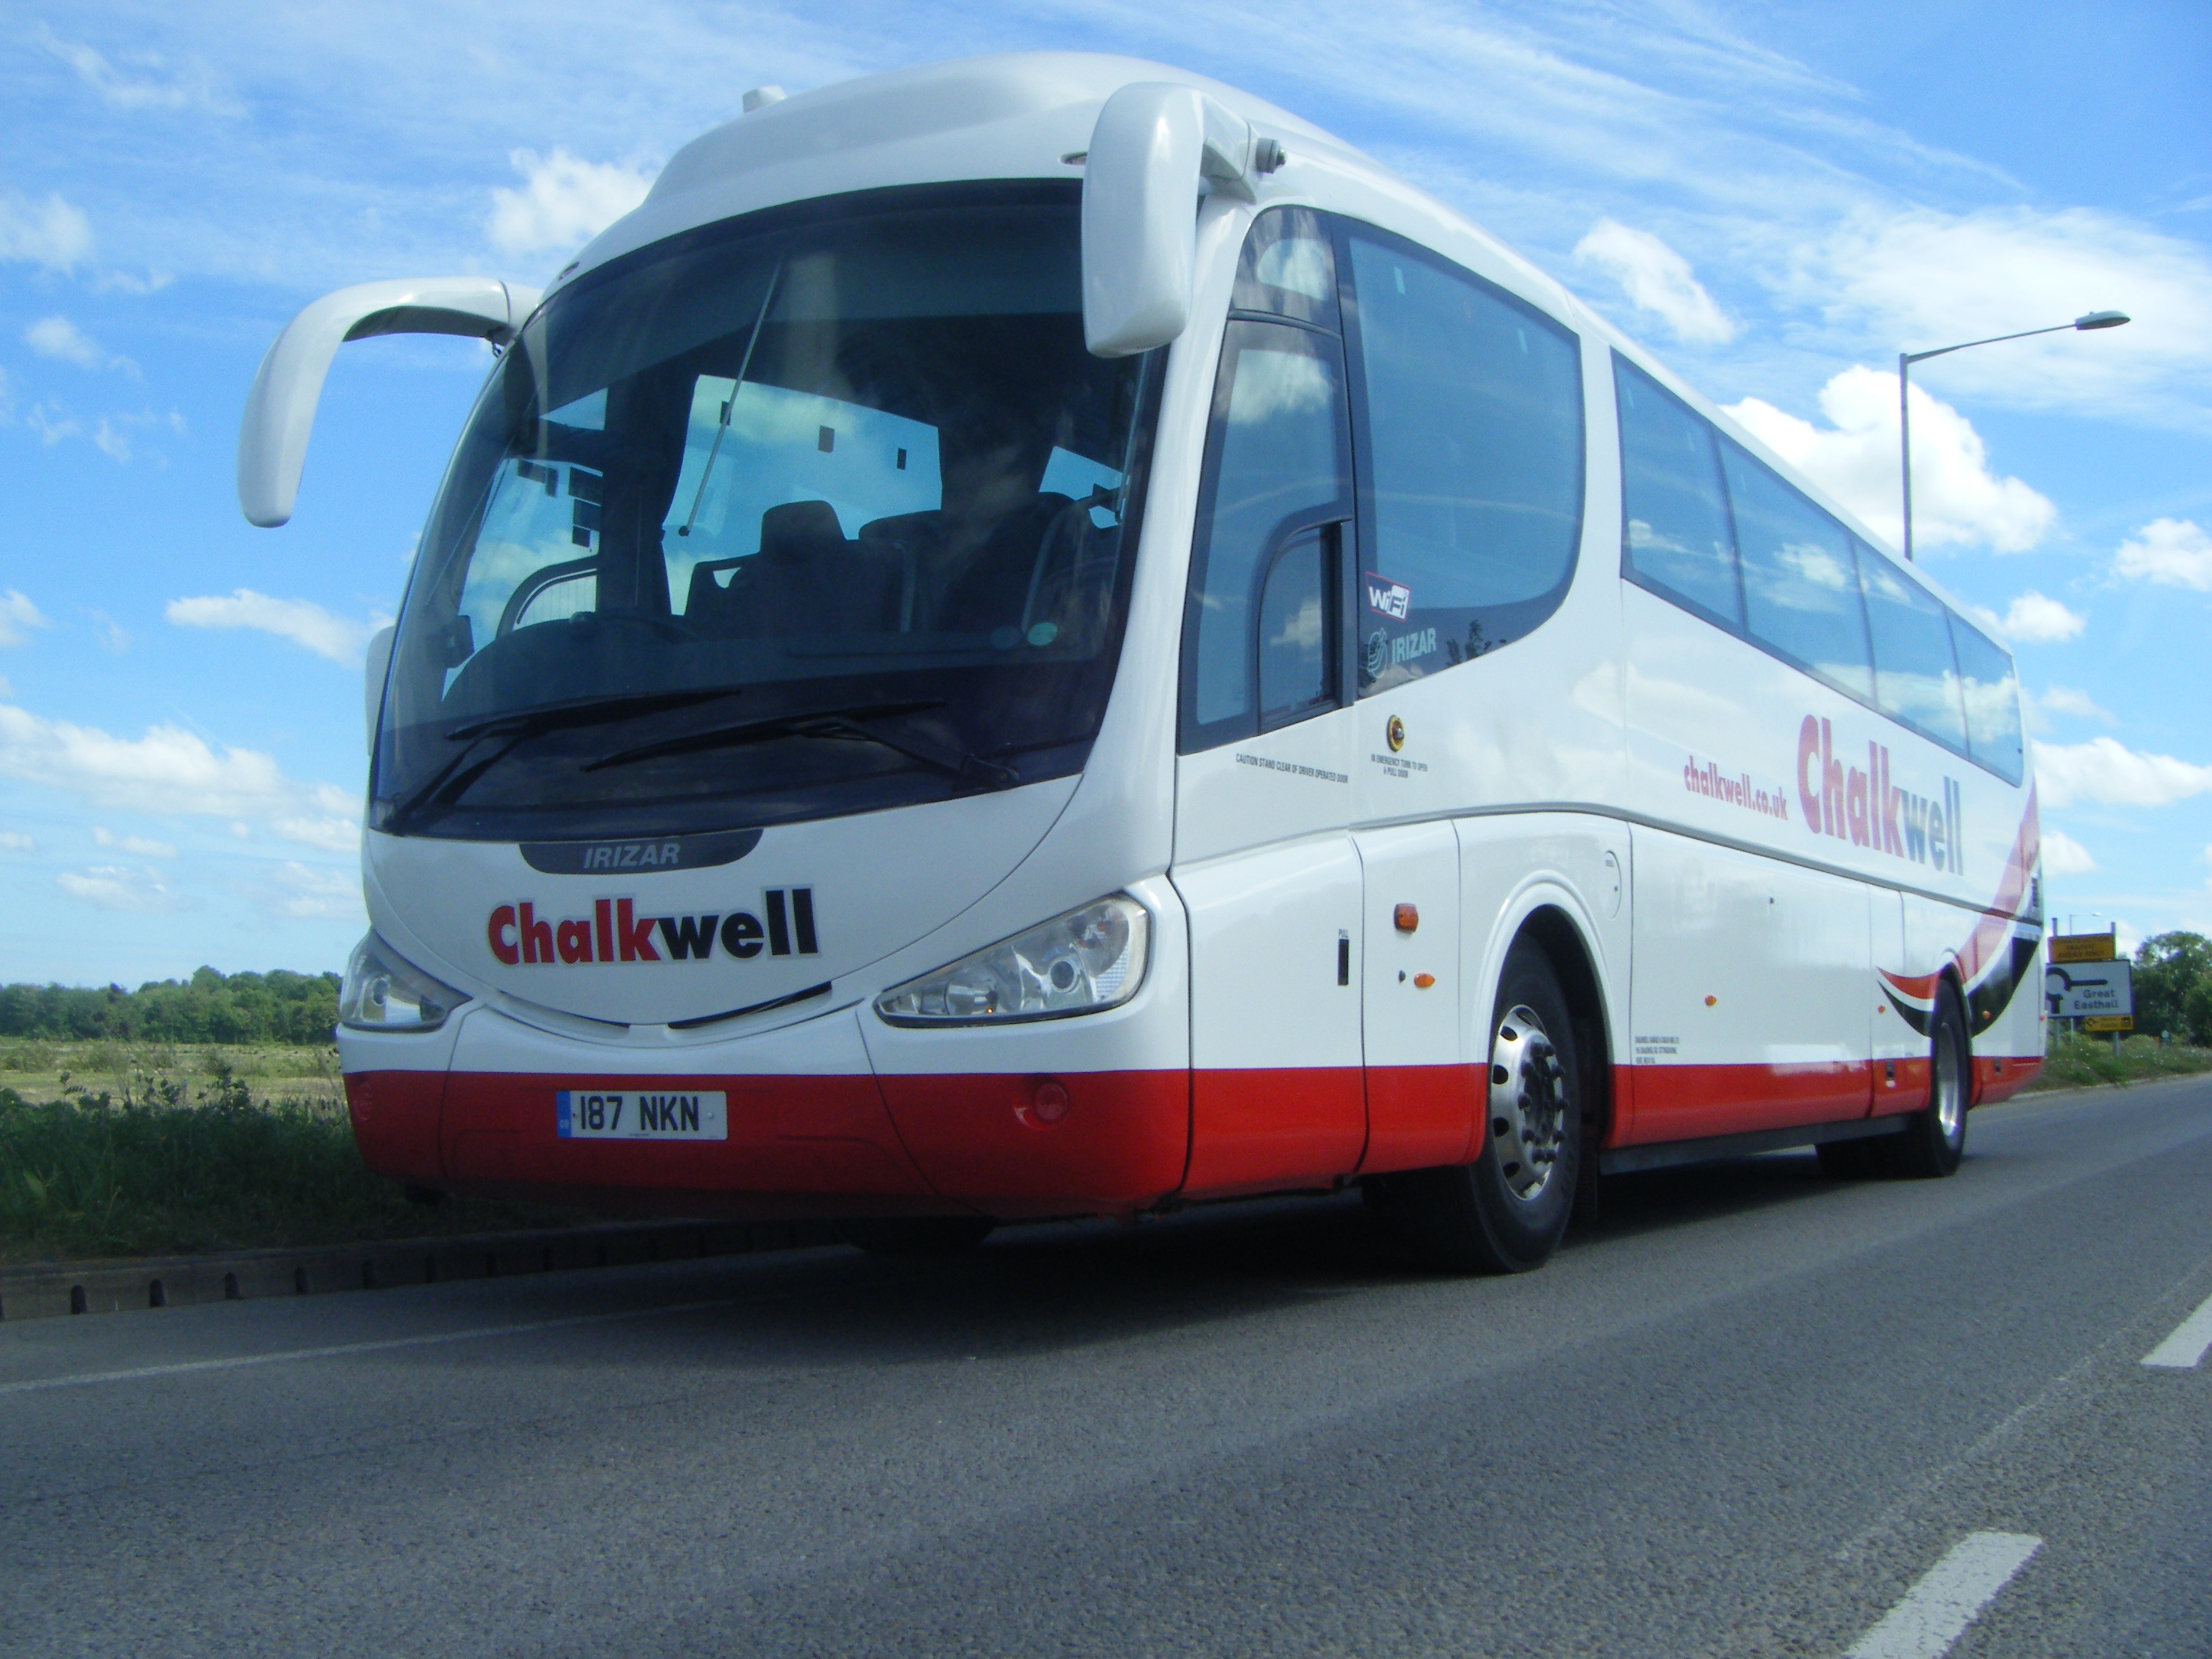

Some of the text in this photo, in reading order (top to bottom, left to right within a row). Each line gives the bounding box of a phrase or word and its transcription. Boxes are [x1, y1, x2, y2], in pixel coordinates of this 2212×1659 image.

[1392, 627, 1437, 664] IRIZAR
[1236, 753, 1349, 783] CAUTION STAND CLEAR OF DRIVER OPERATED DOOR
[1376, 755, 1400, 766] EMERGENCY
[1683, 755, 1788, 821] chalkwell.co.uk
[1797, 714, 1964, 876] Chalkwell
[584, 843, 680, 868] IRIZAR
[487, 888, 818, 965] Chalkwell
[2074, 999, 2118, 1010] Easthall
[2083, 989, 2115, 999] Great
[639, 1096, 699, 1131] NKN
